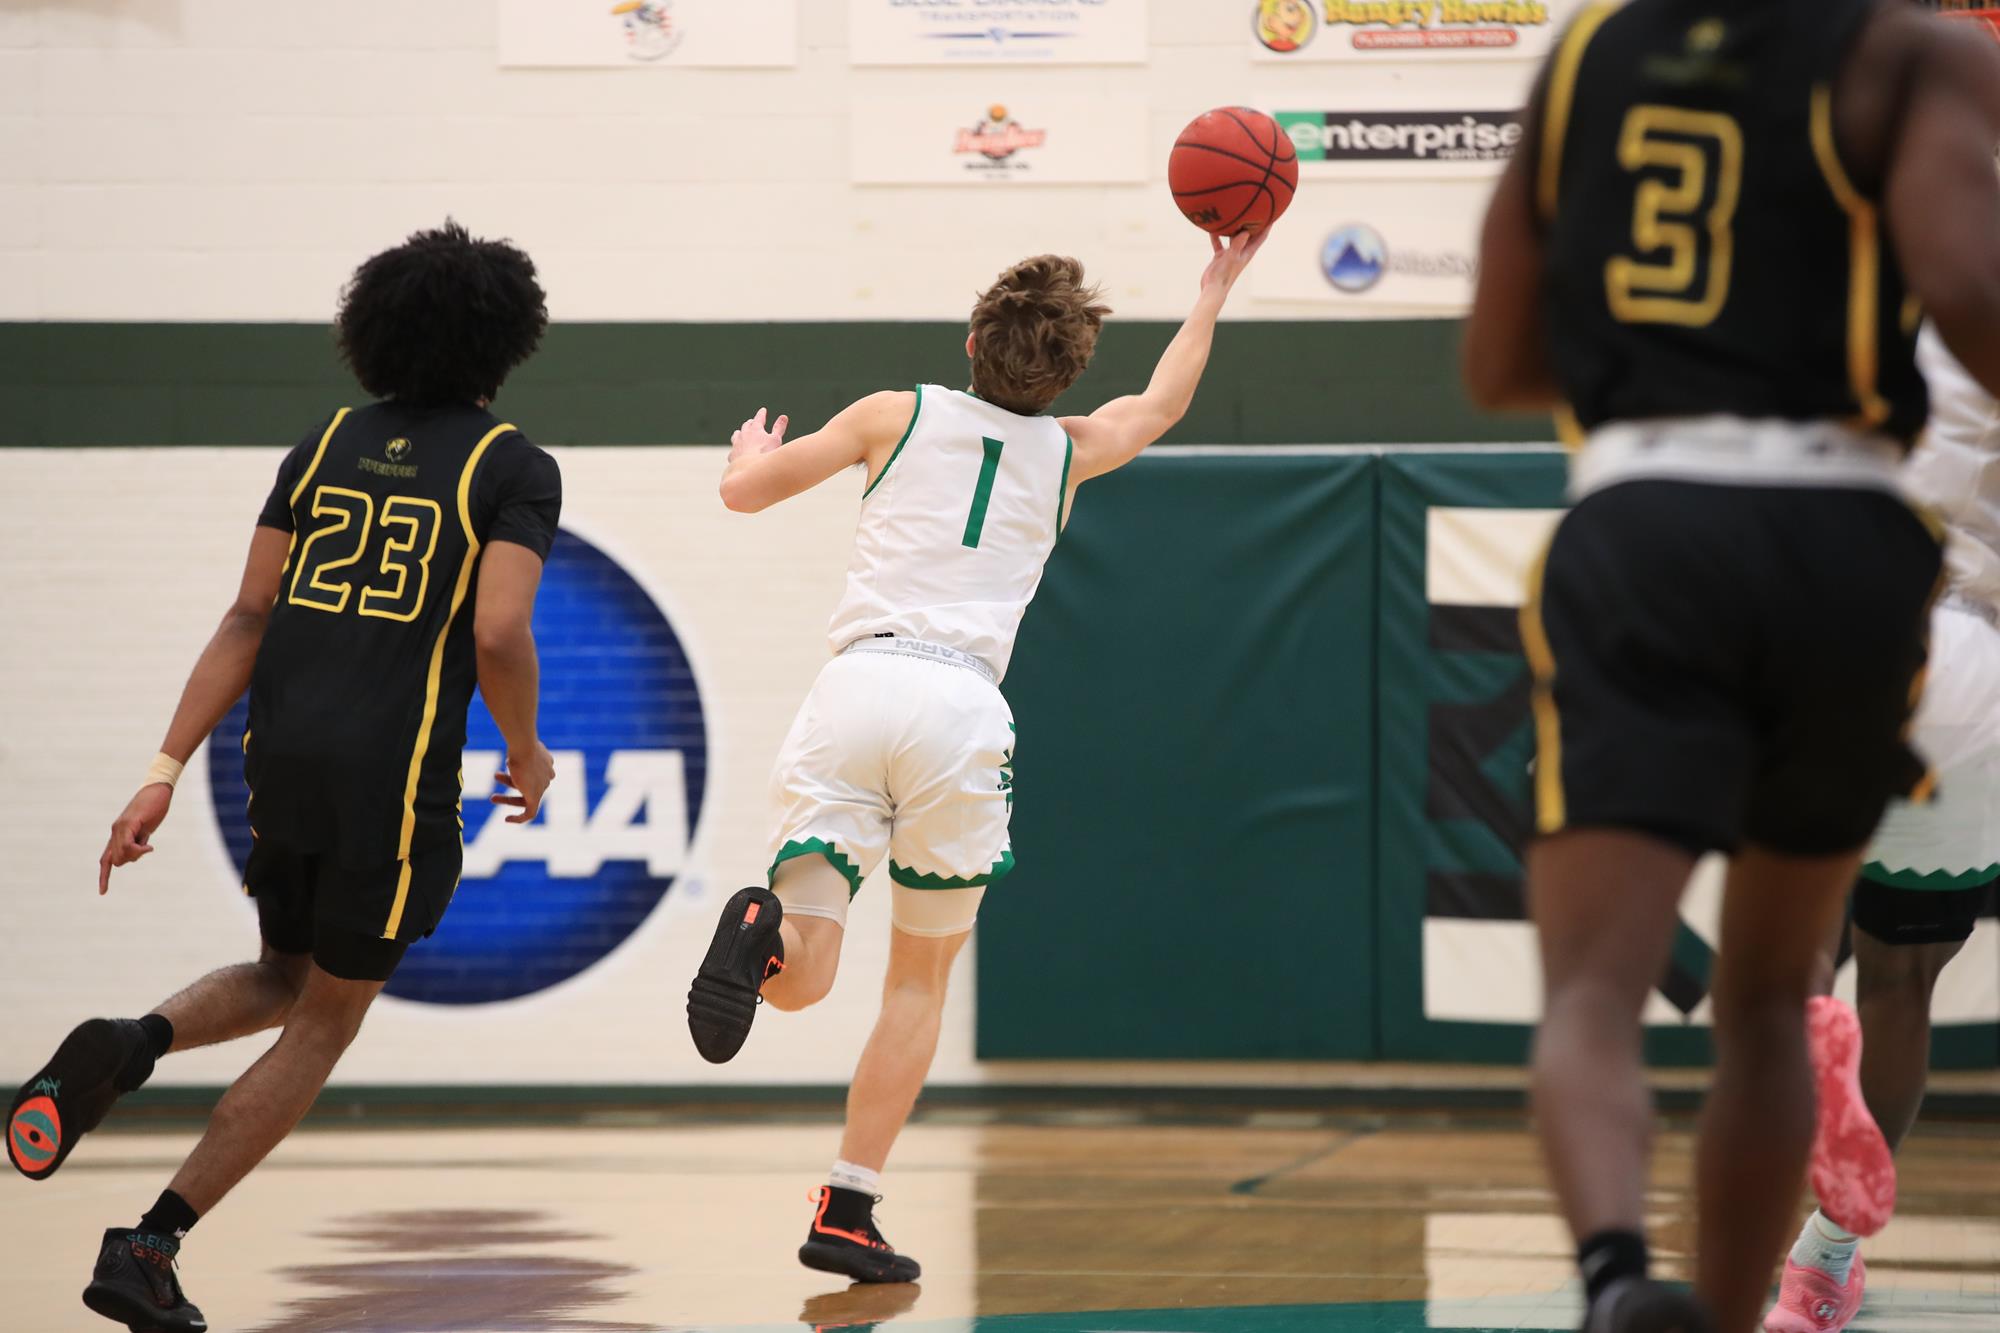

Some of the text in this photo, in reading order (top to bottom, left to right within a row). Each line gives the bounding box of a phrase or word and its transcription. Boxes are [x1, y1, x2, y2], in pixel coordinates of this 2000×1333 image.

[1286, 116, 1523, 157] enterprise
[1606, 106, 1742, 325] 3
[288, 485, 442, 622] 23
[962, 436, 1004, 549] 1
